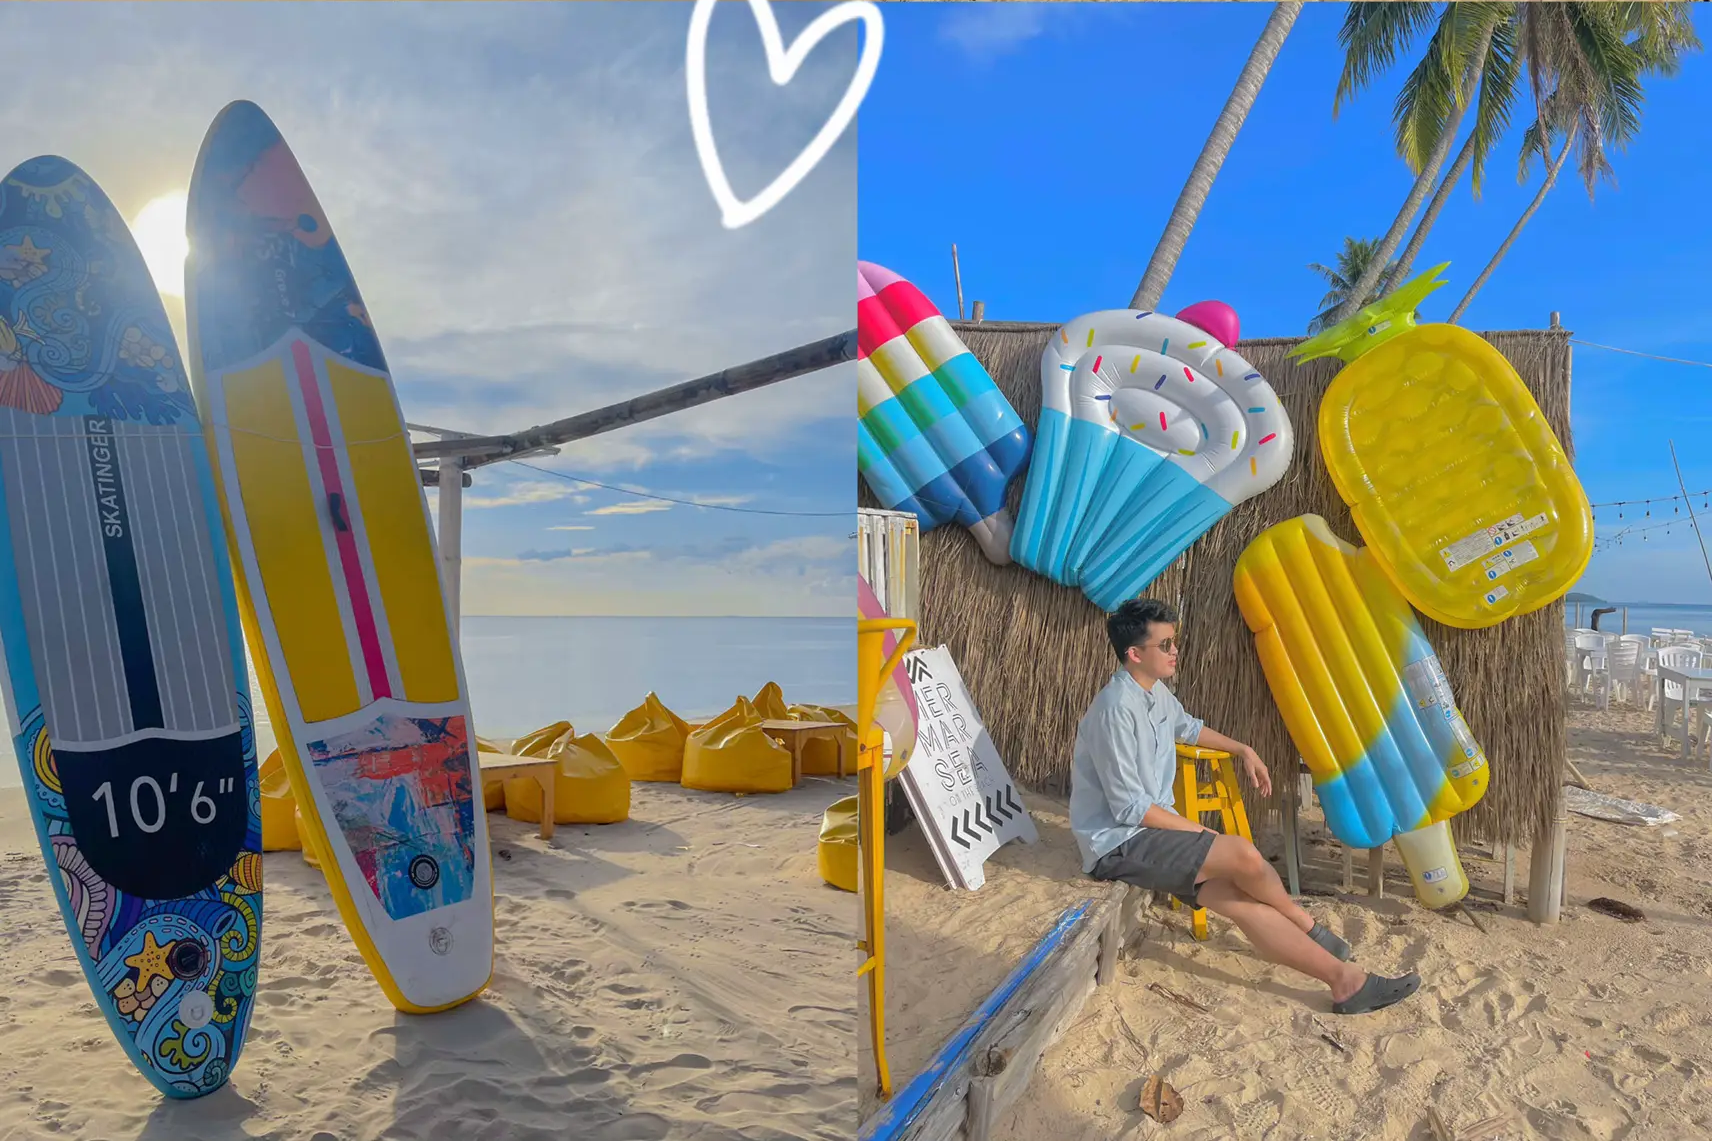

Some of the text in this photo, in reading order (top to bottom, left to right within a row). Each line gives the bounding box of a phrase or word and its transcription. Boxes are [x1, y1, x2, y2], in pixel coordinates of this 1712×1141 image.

[89, 418, 123, 539] SKATINGER
[918, 713, 972, 758] MAR
[934, 746, 988, 792] SEA
